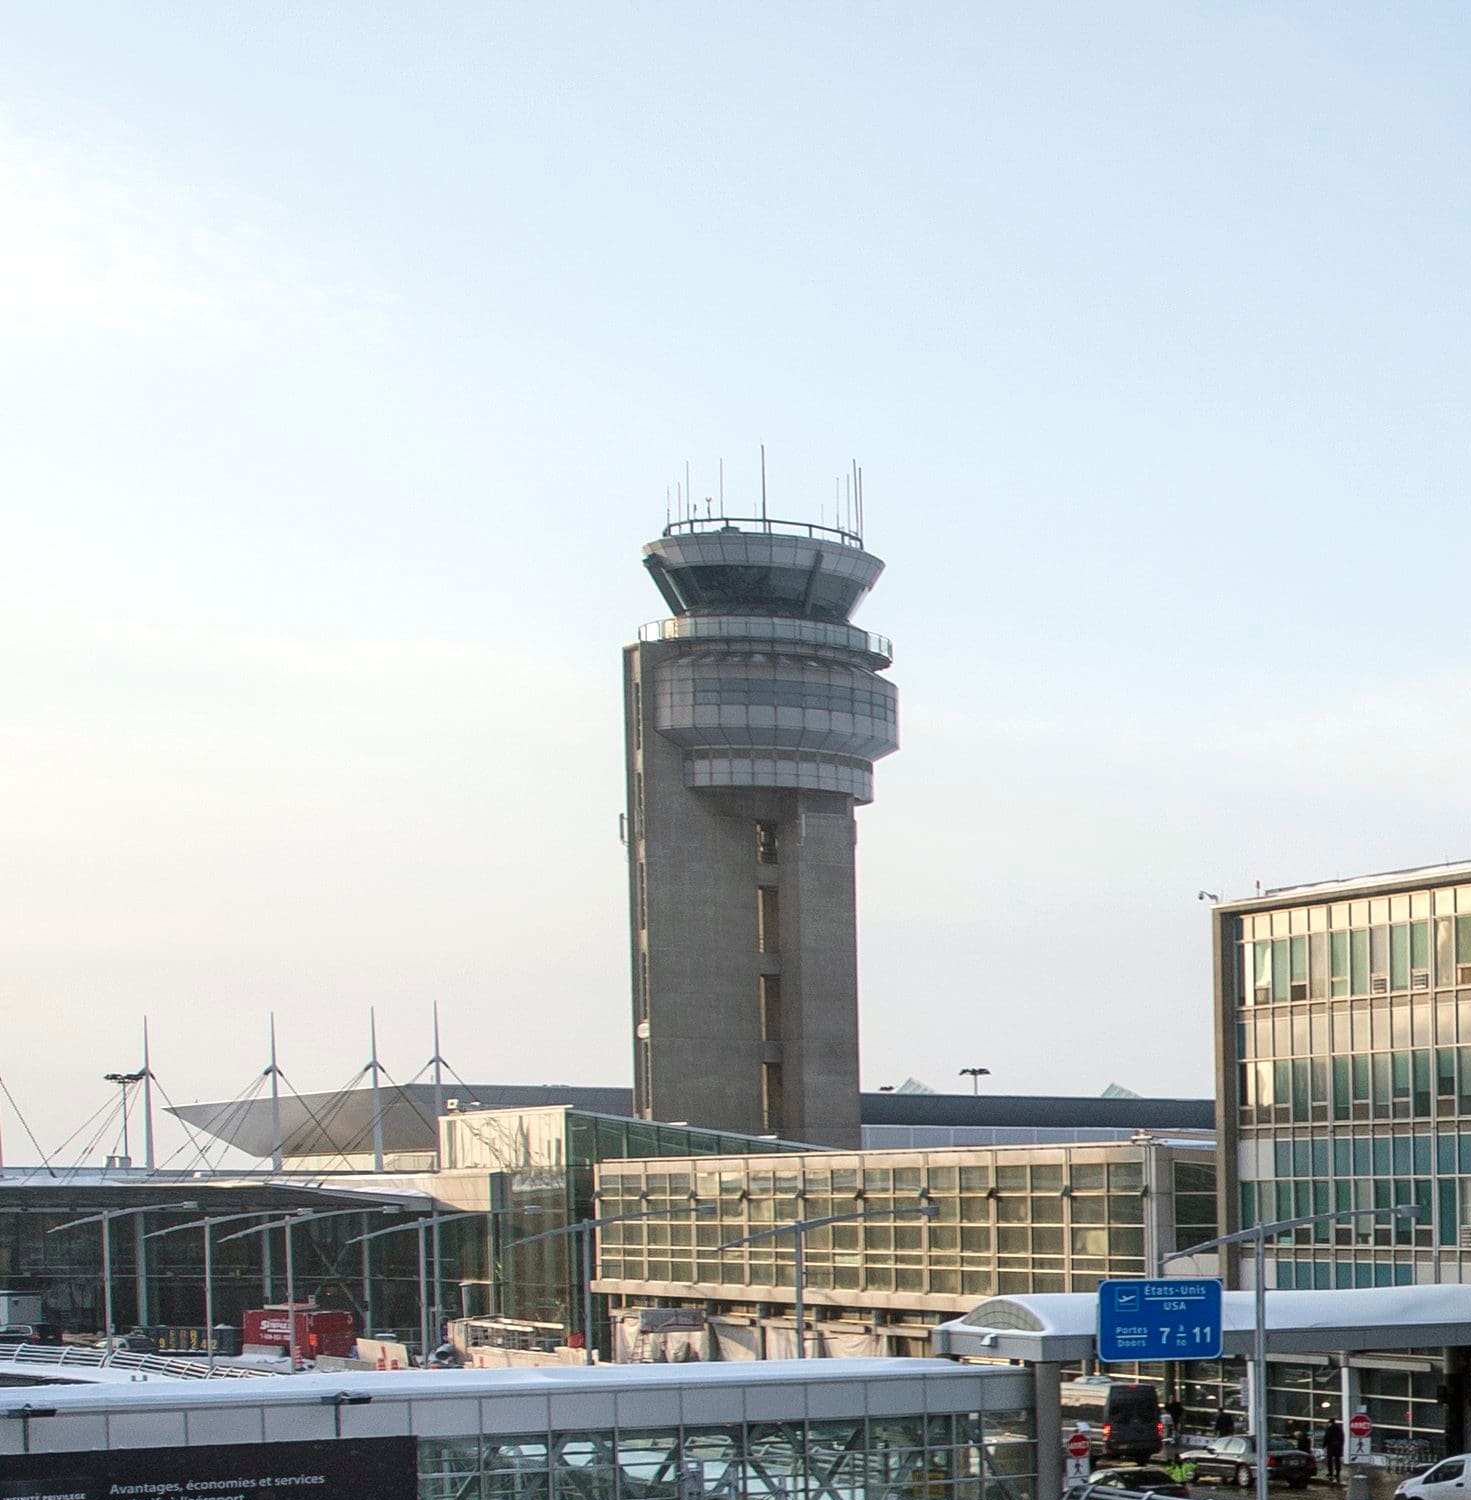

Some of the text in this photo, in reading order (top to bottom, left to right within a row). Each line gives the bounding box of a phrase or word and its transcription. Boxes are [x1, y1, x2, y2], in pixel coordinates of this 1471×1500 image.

[1144, 1284, 1206, 1296] États-Unis
[1163, 1301, 1187, 1311] USA
[1116, 1326, 1148, 1334] Portes
[1160, 1327, 1170, 1344] 7
[1193, 1326, 1212, 1343] 11
[1117, 1339, 1147, 1347] Doors
[109, 1473, 326, 1496] Avantages, économies et services
